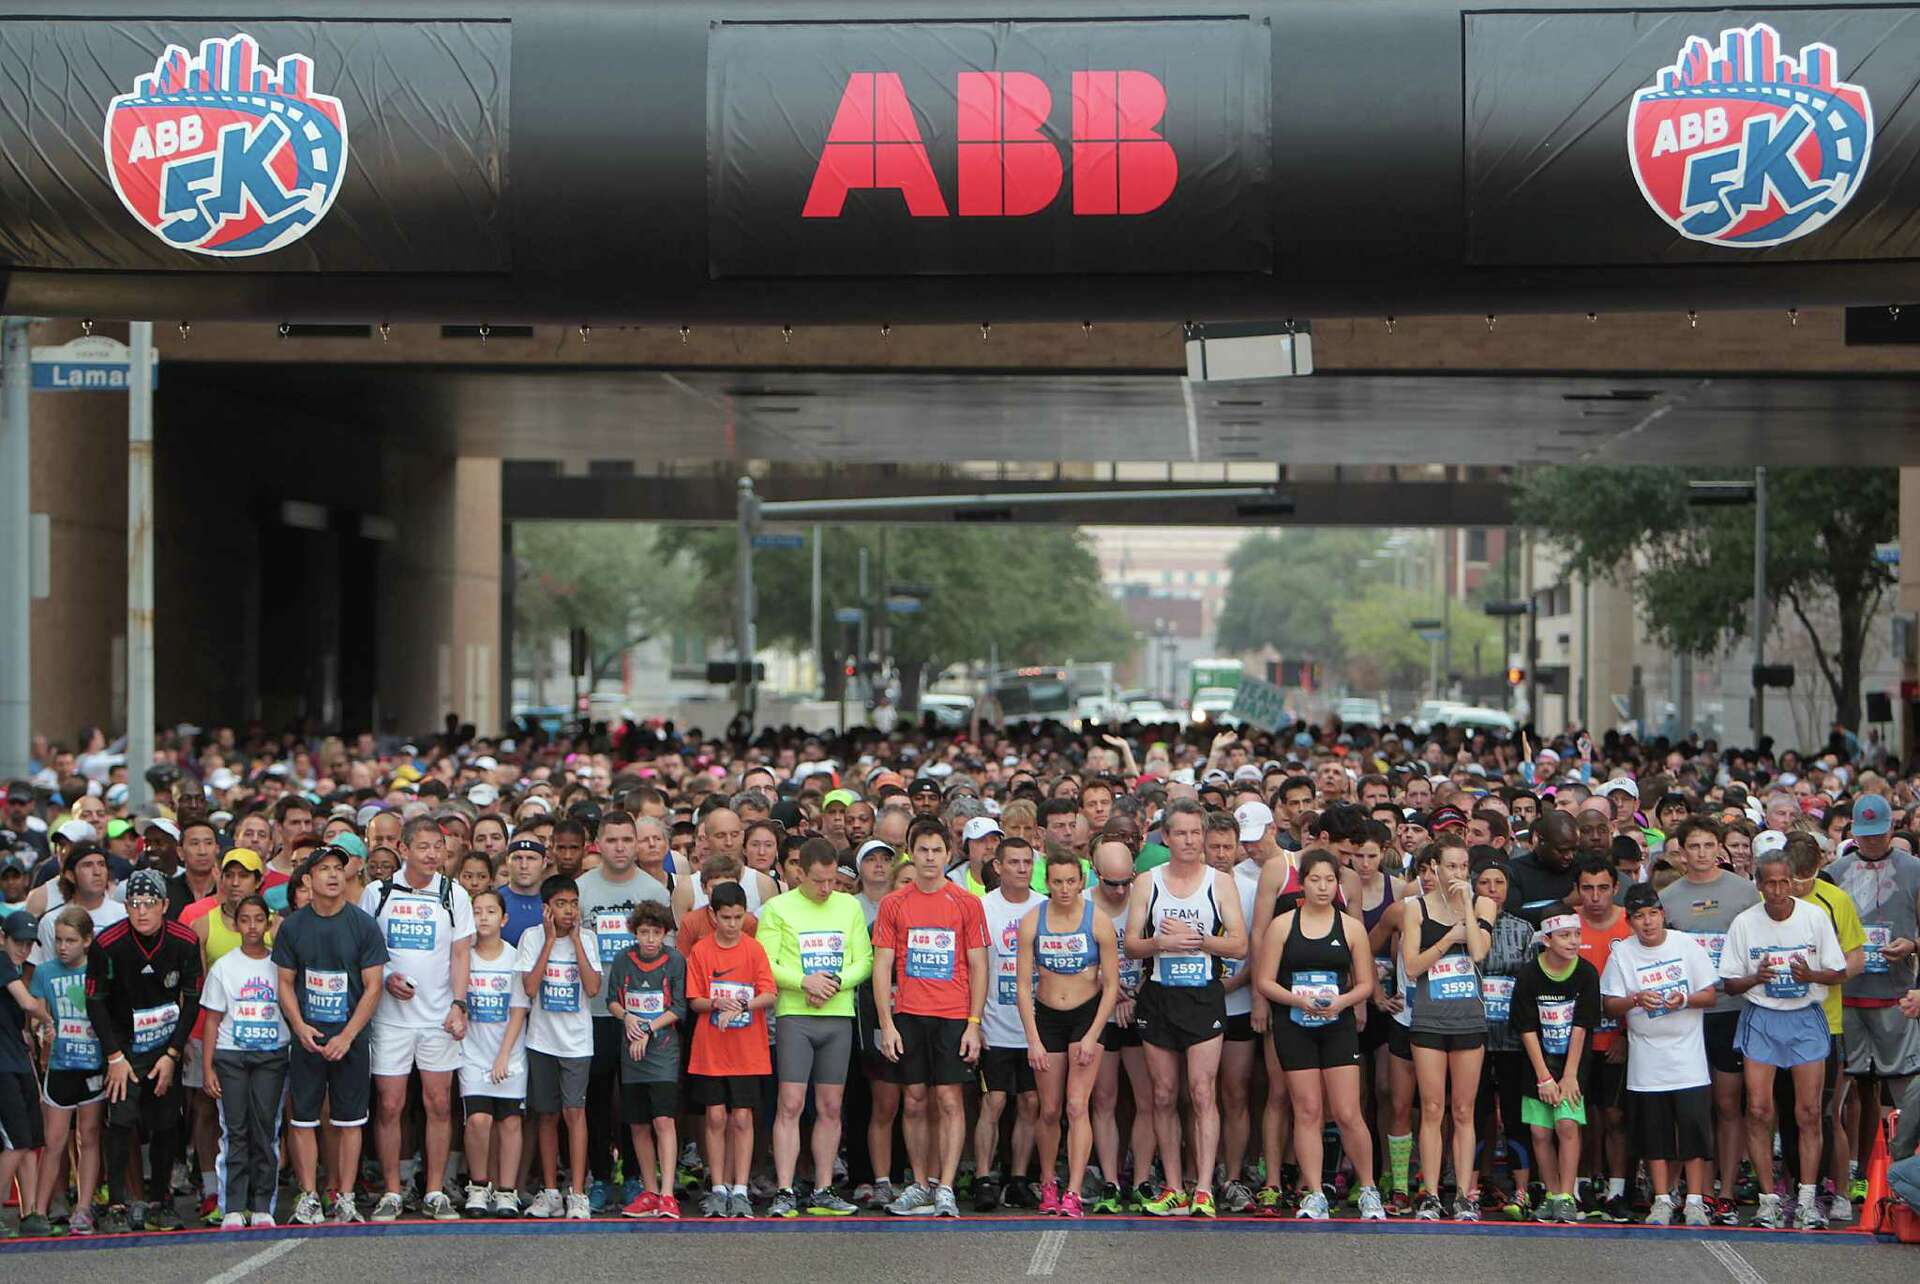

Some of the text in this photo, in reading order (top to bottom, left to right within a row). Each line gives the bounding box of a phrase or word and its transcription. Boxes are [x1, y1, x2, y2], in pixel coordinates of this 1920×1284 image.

[1652, 107, 1728, 158] ABB
[128, 115, 204, 164] ABB
[801, 70, 1179, 217] ABB
[1680, 104, 1837, 238] 5K
[159, 112, 311, 246] 5K
[392, 905, 413, 915] ABB
[1163, 908, 1199, 919] TEAM
[391, 924, 433, 936] M2193
[601, 920, 621, 929] ABB
[803, 940, 824, 949] ABB
[911, 934, 931, 945] ABB
[1042, 941, 1063, 951] ABB
[803, 955, 843, 968] M2089
[911, 952, 950, 965] M1213
[1044, 957, 1083, 970] F1927
[1171, 963, 1204, 975] 2597
[1431, 963, 1452, 975] ABB
[308, 976, 324, 987] ABB
[1642, 972, 1663, 984] ABB
[544, 987, 575, 998] M102
[1441, 981, 1475, 994] 3599
[308, 994, 343, 1007] M1177
[471, 996, 504, 1008] F2191
[236, 1006, 257, 1016] ABB
[62, 1023, 82, 1034] ABB
[65, 1042, 96, 1055] F153
